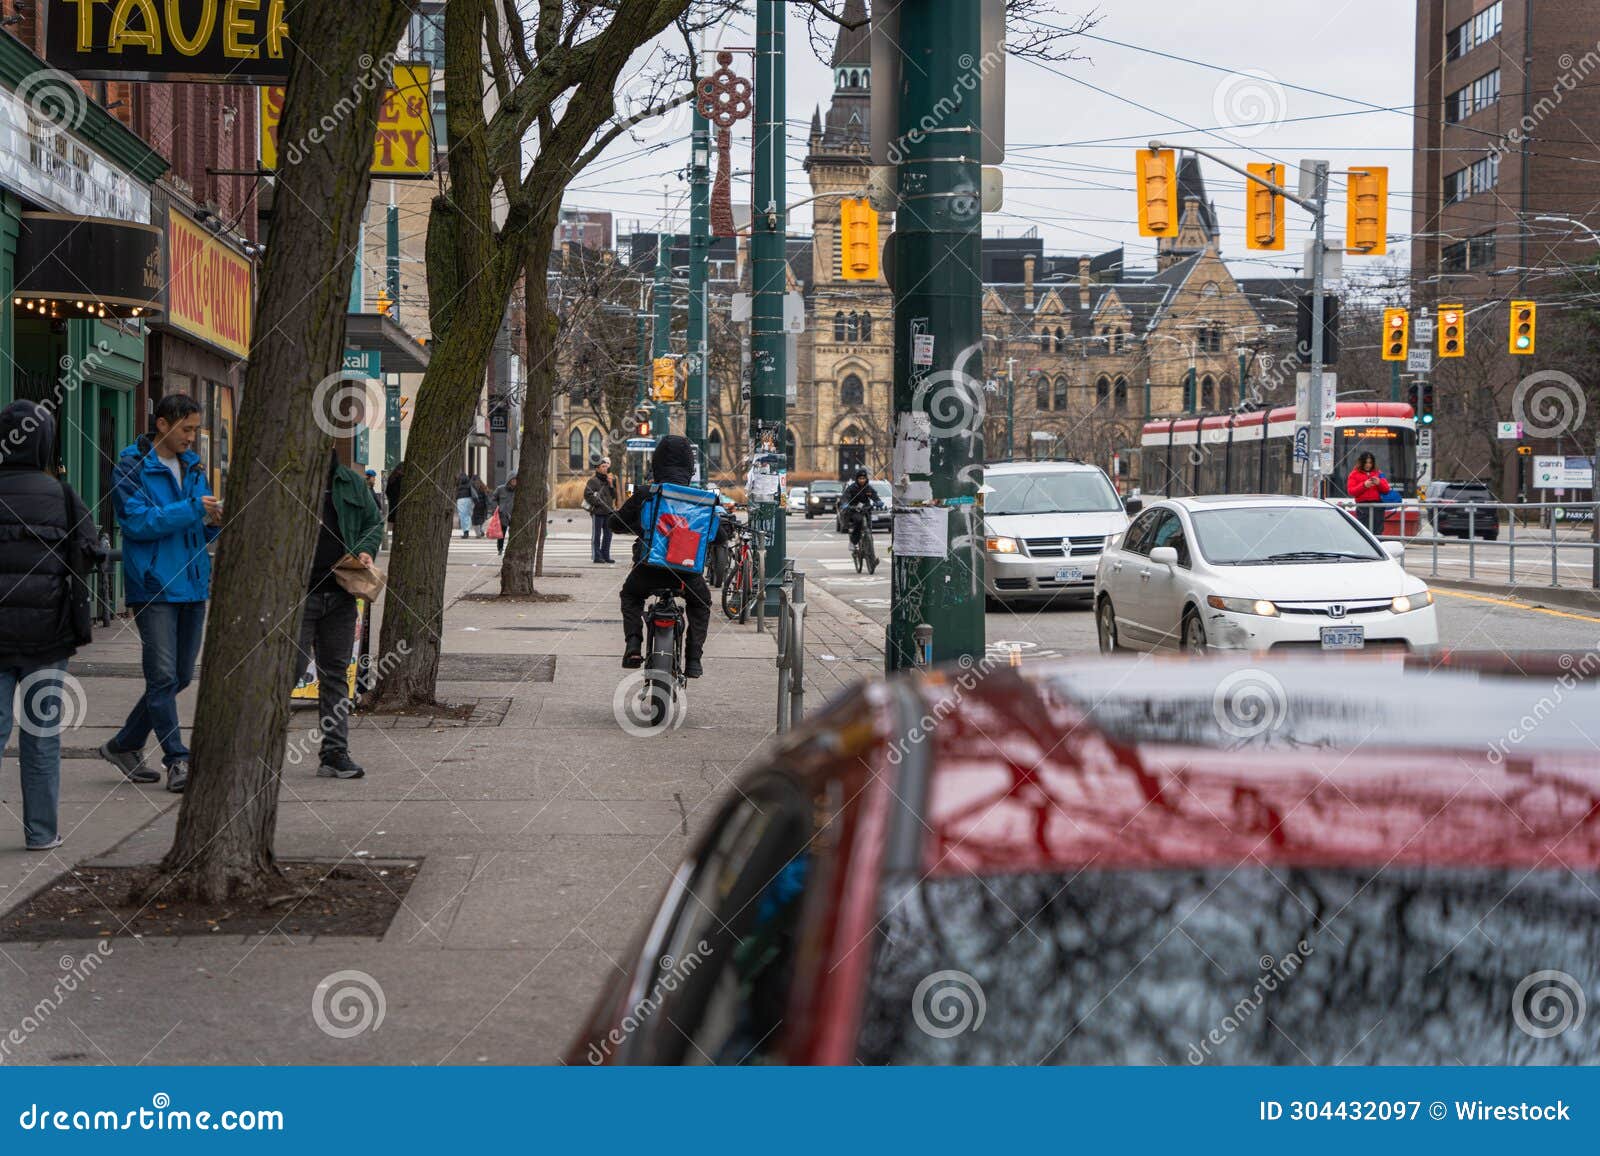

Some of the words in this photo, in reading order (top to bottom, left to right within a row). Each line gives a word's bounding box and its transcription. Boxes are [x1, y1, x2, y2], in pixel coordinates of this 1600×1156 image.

[63, 0, 289, 59] TAVER
[169, 220, 204, 326] MOKE
[210, 247, 250, 348] VARIETY
[342, 353, 369, 368] xall
[1409, 351, 1430, 360] TRANSIT
